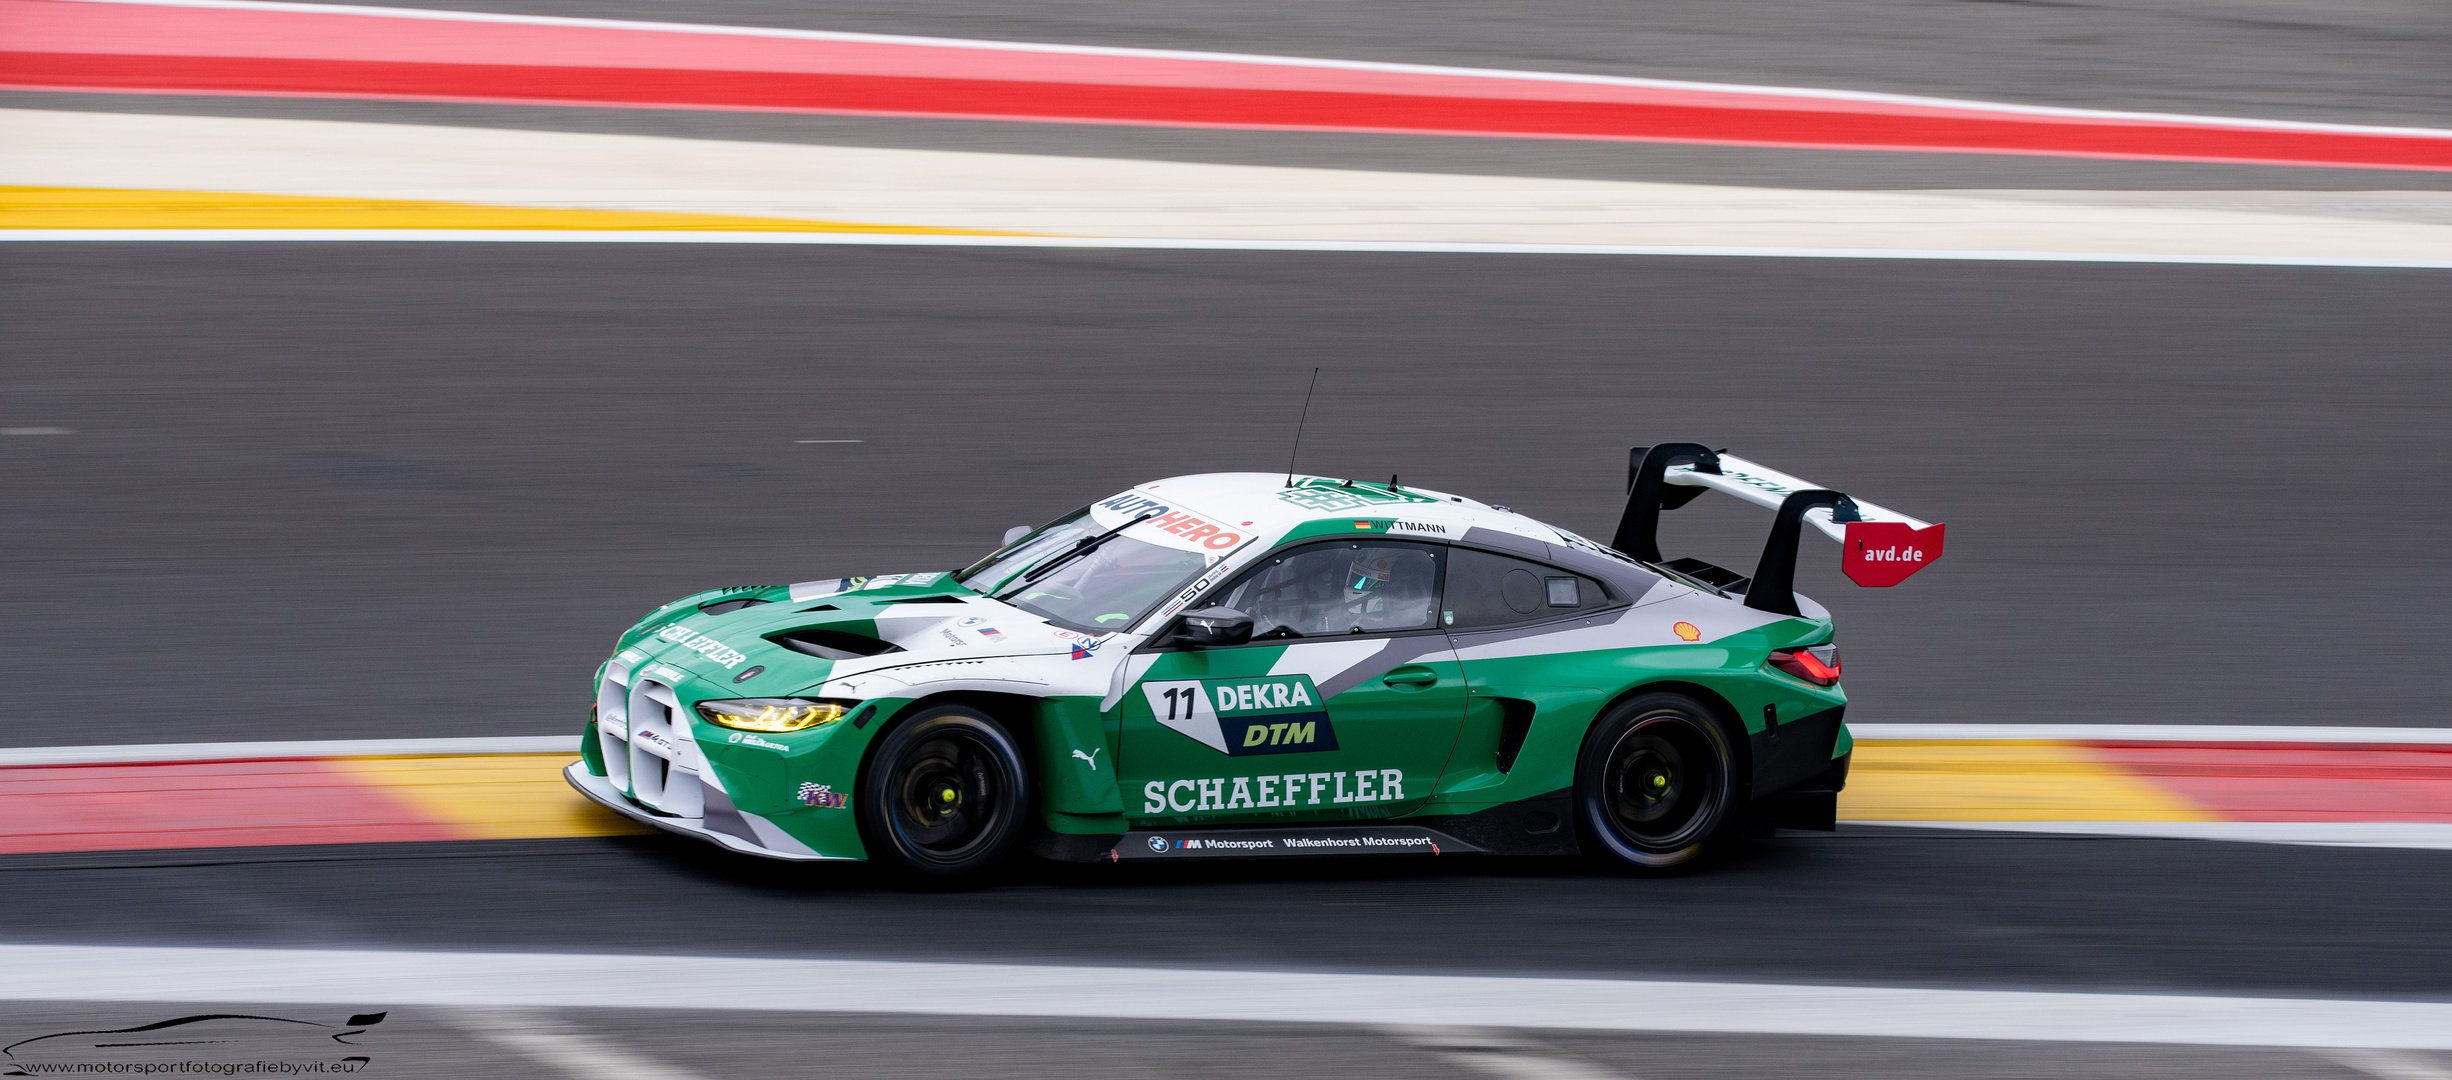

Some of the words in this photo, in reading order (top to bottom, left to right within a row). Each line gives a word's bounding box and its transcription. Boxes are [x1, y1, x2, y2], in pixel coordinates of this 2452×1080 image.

[1098, 494, 1241, 549] AUTOHERO
[1370, 520, 1446, 534] WITTMANN
[1864, 545, 1923, 563] avd.de
[1163, 687, 1196, 720] 11
[1216, 681, 1312, 711] DEKRA
[1243, 721, 1316, 747] DTM
[805, 790, 849, 809] KW
[1144, 768, 1404, 814] SCHAEFFLER
[1205, 839, 1274, 850] Motorsport
[1283, 837, 1361, 848] Walkenhorst
[1363, 836, 1432, 848] Motorsport
